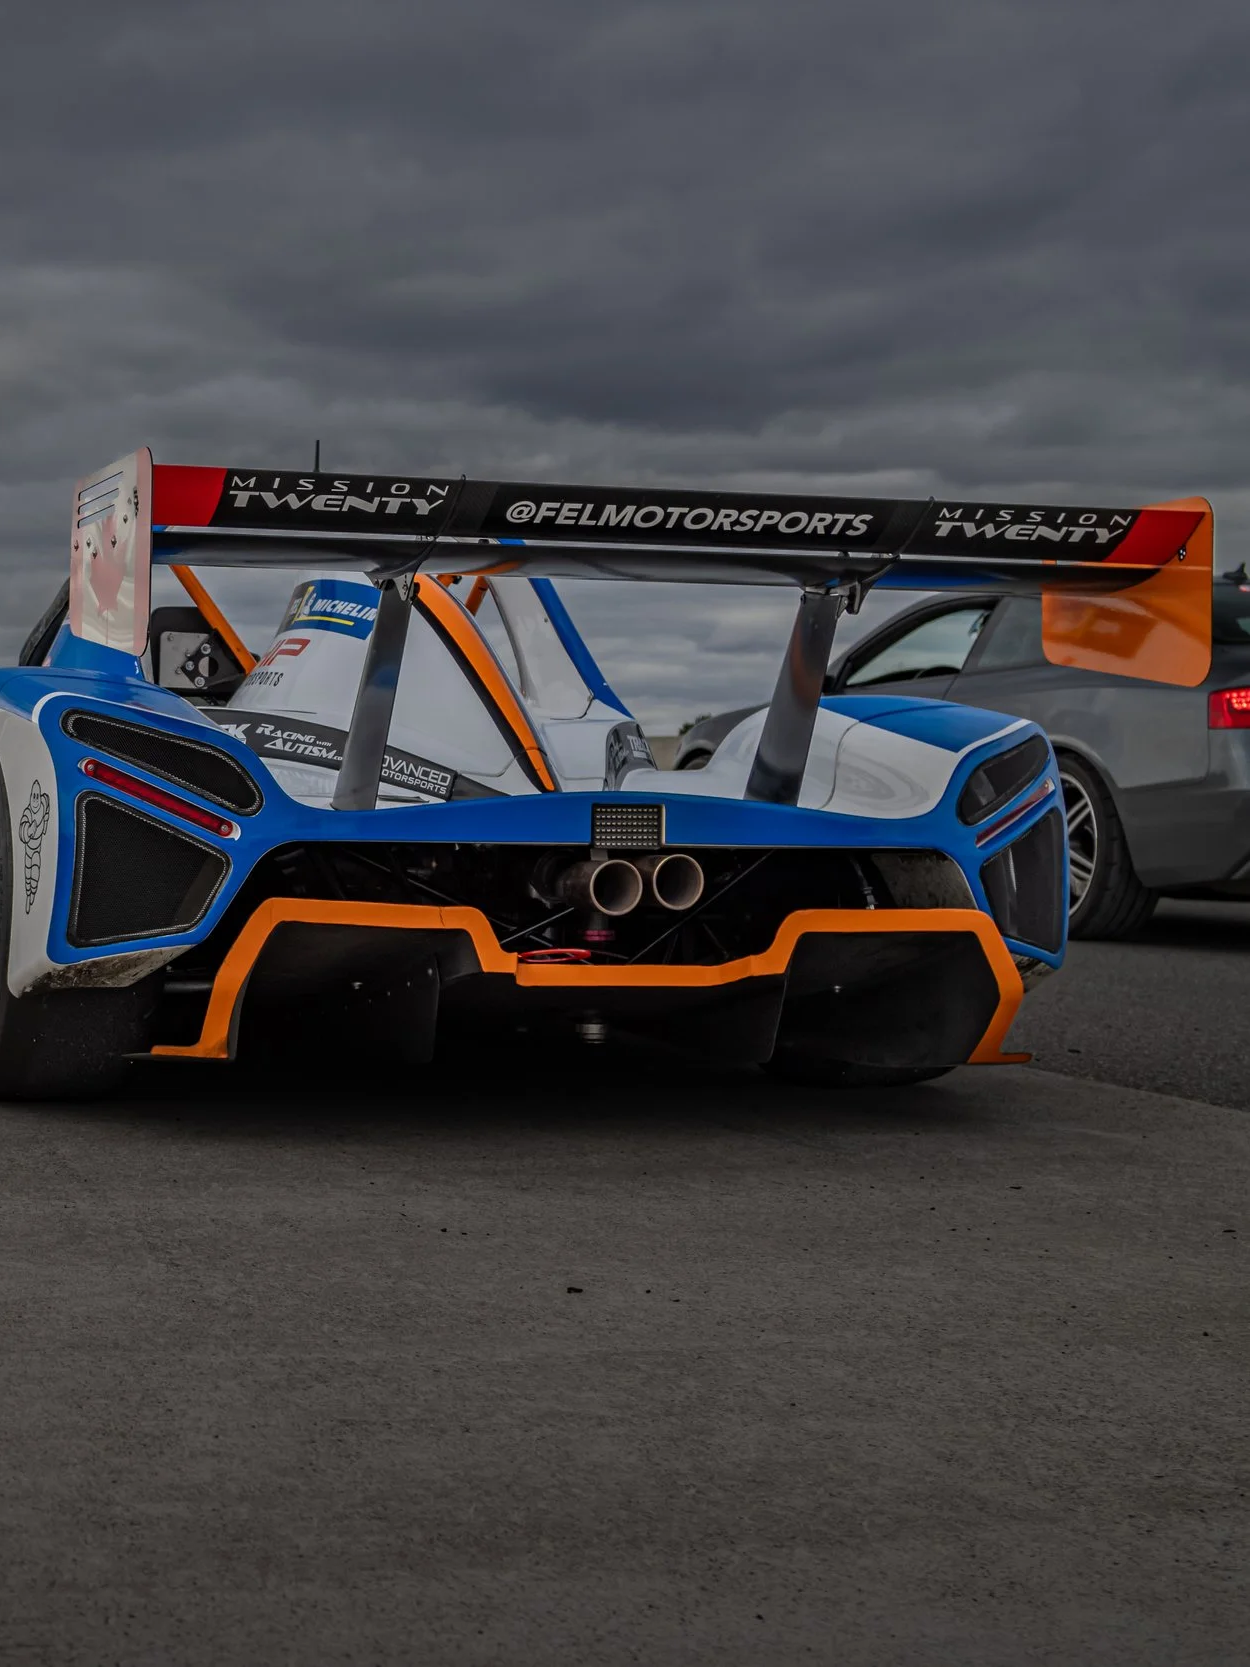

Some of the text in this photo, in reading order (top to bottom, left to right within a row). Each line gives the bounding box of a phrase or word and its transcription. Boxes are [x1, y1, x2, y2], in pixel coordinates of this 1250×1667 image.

[231, 475, 449, 497] MISSION
[229, 490, 444, 515] TWENTY
[505, 500, 873, 536] @FELMOTORSPORTS
[938, 507, 1132, 527] MISSION
[935, 520, 1124, 544] TWENTY
[311, 598, 378, 622] MICHELIN
[255, 723, 317, 744] RACING
[264, 737, 343, 761] AUTISM.CO
[381, 769, 448, 795] OTORSPORTS
[382, 754, 451, 787] DVANCED
